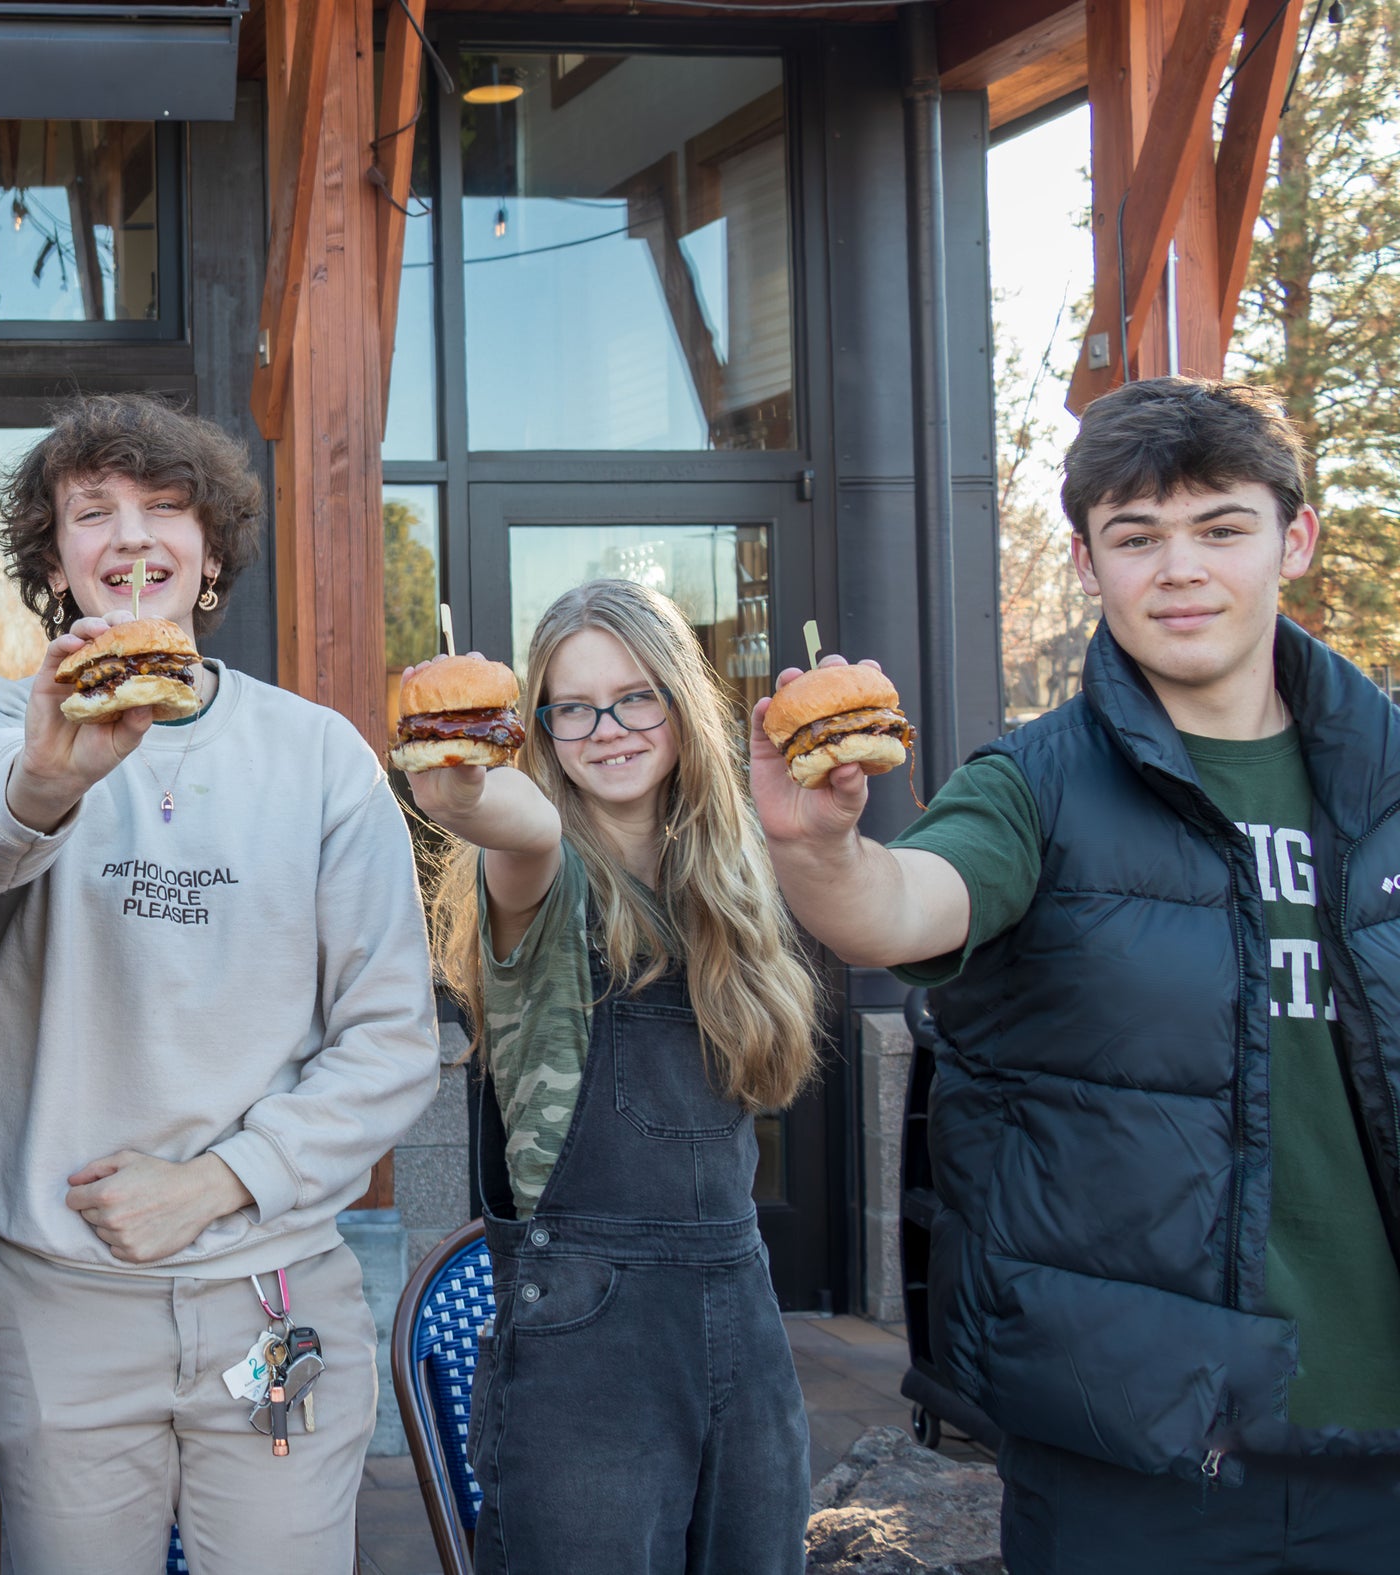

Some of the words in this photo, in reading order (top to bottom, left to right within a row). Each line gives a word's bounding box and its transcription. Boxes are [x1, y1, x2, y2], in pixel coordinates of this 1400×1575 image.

[102, 860, 239, 887] PATHOLOGICAL
[132, 881, 201, 905] PEOPLE
[123, 899, 208, 924] PLEASER
